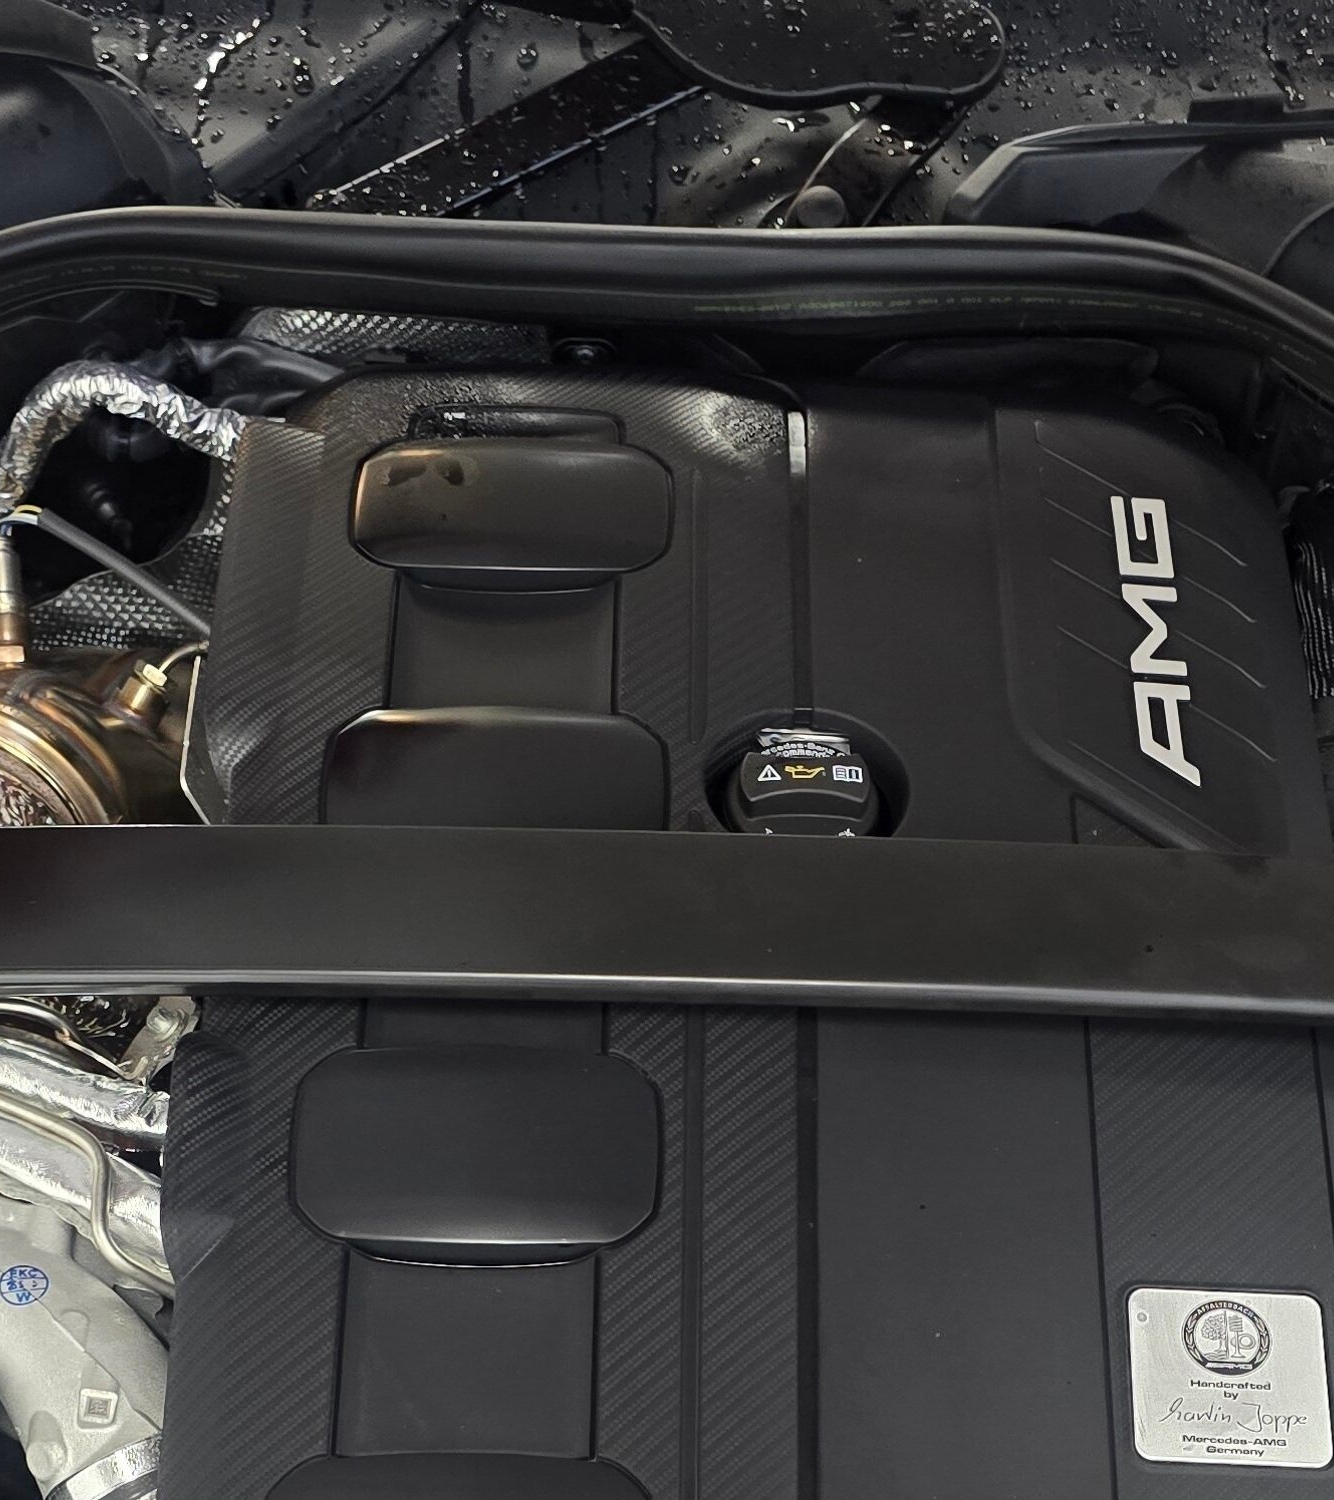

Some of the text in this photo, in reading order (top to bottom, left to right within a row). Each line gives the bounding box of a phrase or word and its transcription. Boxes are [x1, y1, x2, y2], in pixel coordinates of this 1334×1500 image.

[1110, 495, 1201, 787] AMG
[1190, 1379, 1271, 1390] Handcrafted
[1223, 1390, 1239, 1400] by
[1182, 1434, 1287, 1447] Mercedes-AMG
[1206, 1446, 1265, 1458] Germany
